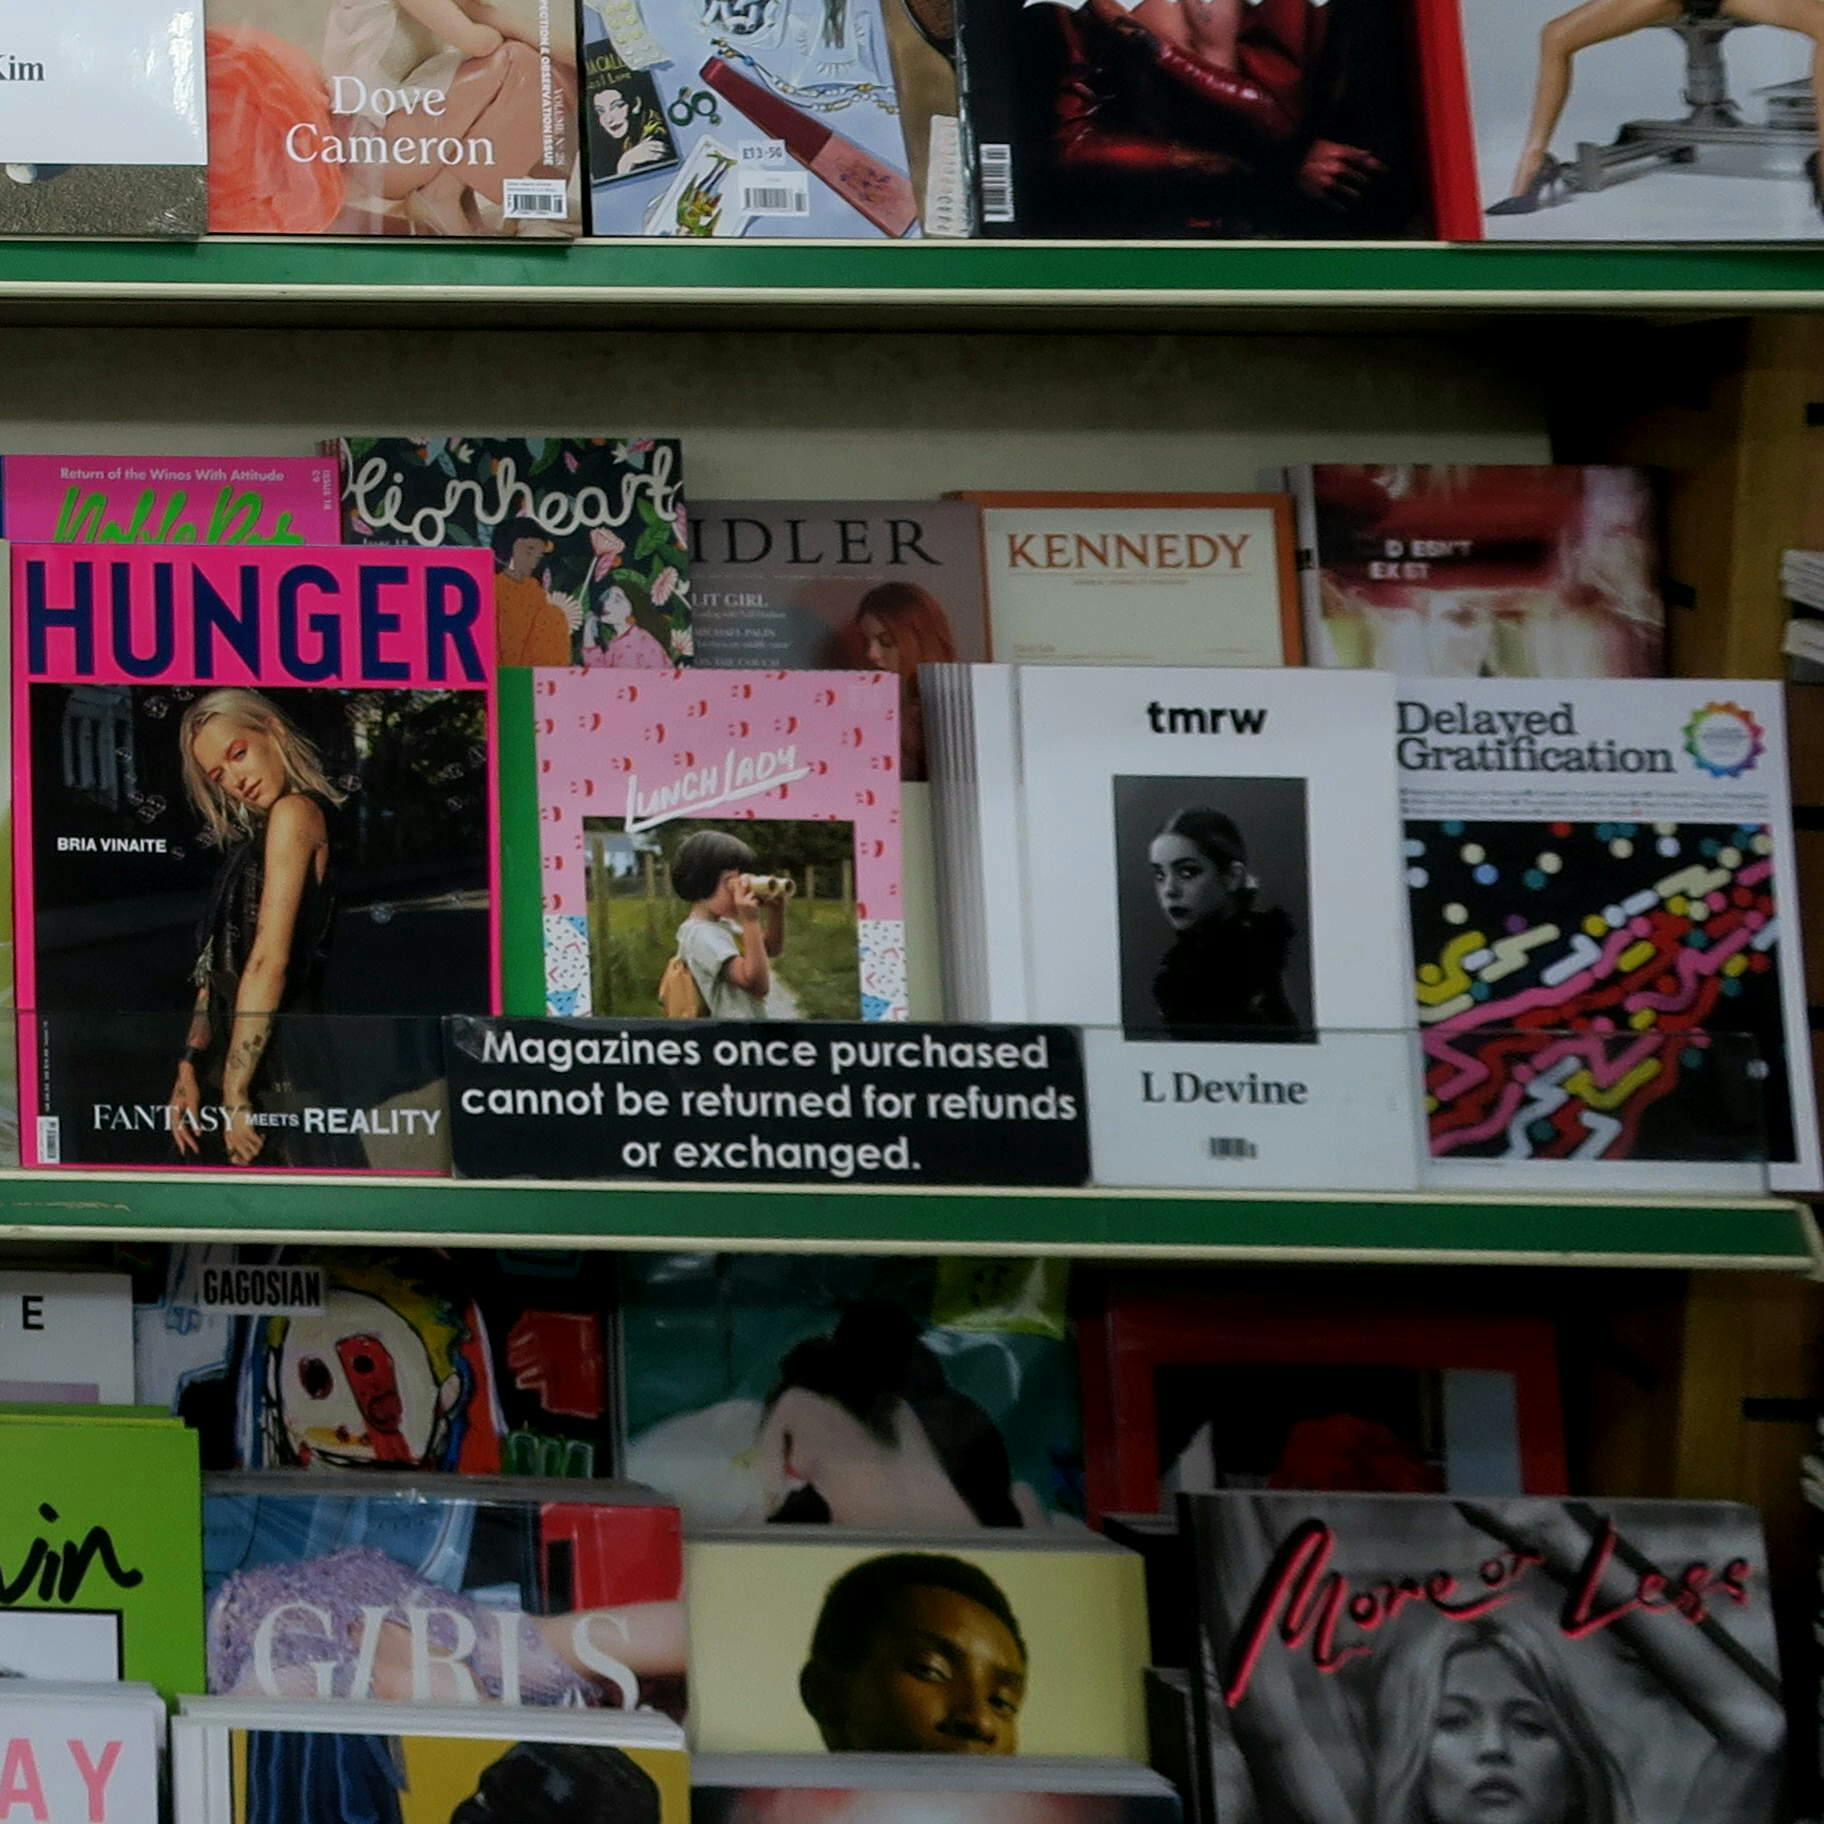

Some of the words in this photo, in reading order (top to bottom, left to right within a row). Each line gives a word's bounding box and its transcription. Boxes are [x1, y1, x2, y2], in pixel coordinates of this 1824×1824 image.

[332, 74, 448, 120] Dove
[284, 122, 497, 169] Cameron
[60, 467, 104, 480] Return
[108, 467, 121, 480] of
[125, 468, 146, 480] the
[150, 468, 191, 481] Winos
[195, 469, 226, 481] With
[230, 470, 285, 482] Attitude
[345, 452, 680, 546] lionheart
[1006, 532, 1252, 571] KENNEDY
[26, 559, 486, 682] HUNGER
[1147, 700, 1268, 736] tmrw
[1396, 700, 1577, 744] Delayed
[1396, 737, 1677, 773] Gratification
[57, 836, 98, 853] BRIA
[100, 837, 167, 854] VINAITE
[482, 1030, 704, 1072] Magazines
[713, 1036, 819, 1068] once
[830, 1035, 1050, 1074] purchased
[460, 1081, 604, 1118] cannot
[616, 1081, 668, 1118] be
[680, 1081, 852, 1120] returned
[862, 1081, 919, 1120] for
[929, 1082, 1077, 1121] refunds
[1140, 1072, 1169, 1103] L
[1171, 1071, 1309, 1104] Devine
[92, 1103, 244, 1133] FANTASY
[245, 1111, 300, 1128] MEETS
[303, 1107, 441, 1137] REALITY
[622, 1137, 666, 1168] or
[672, 1134, 922, 1175] exchanged.
[201, 1268, 322, 1307] GAGOSIAN
